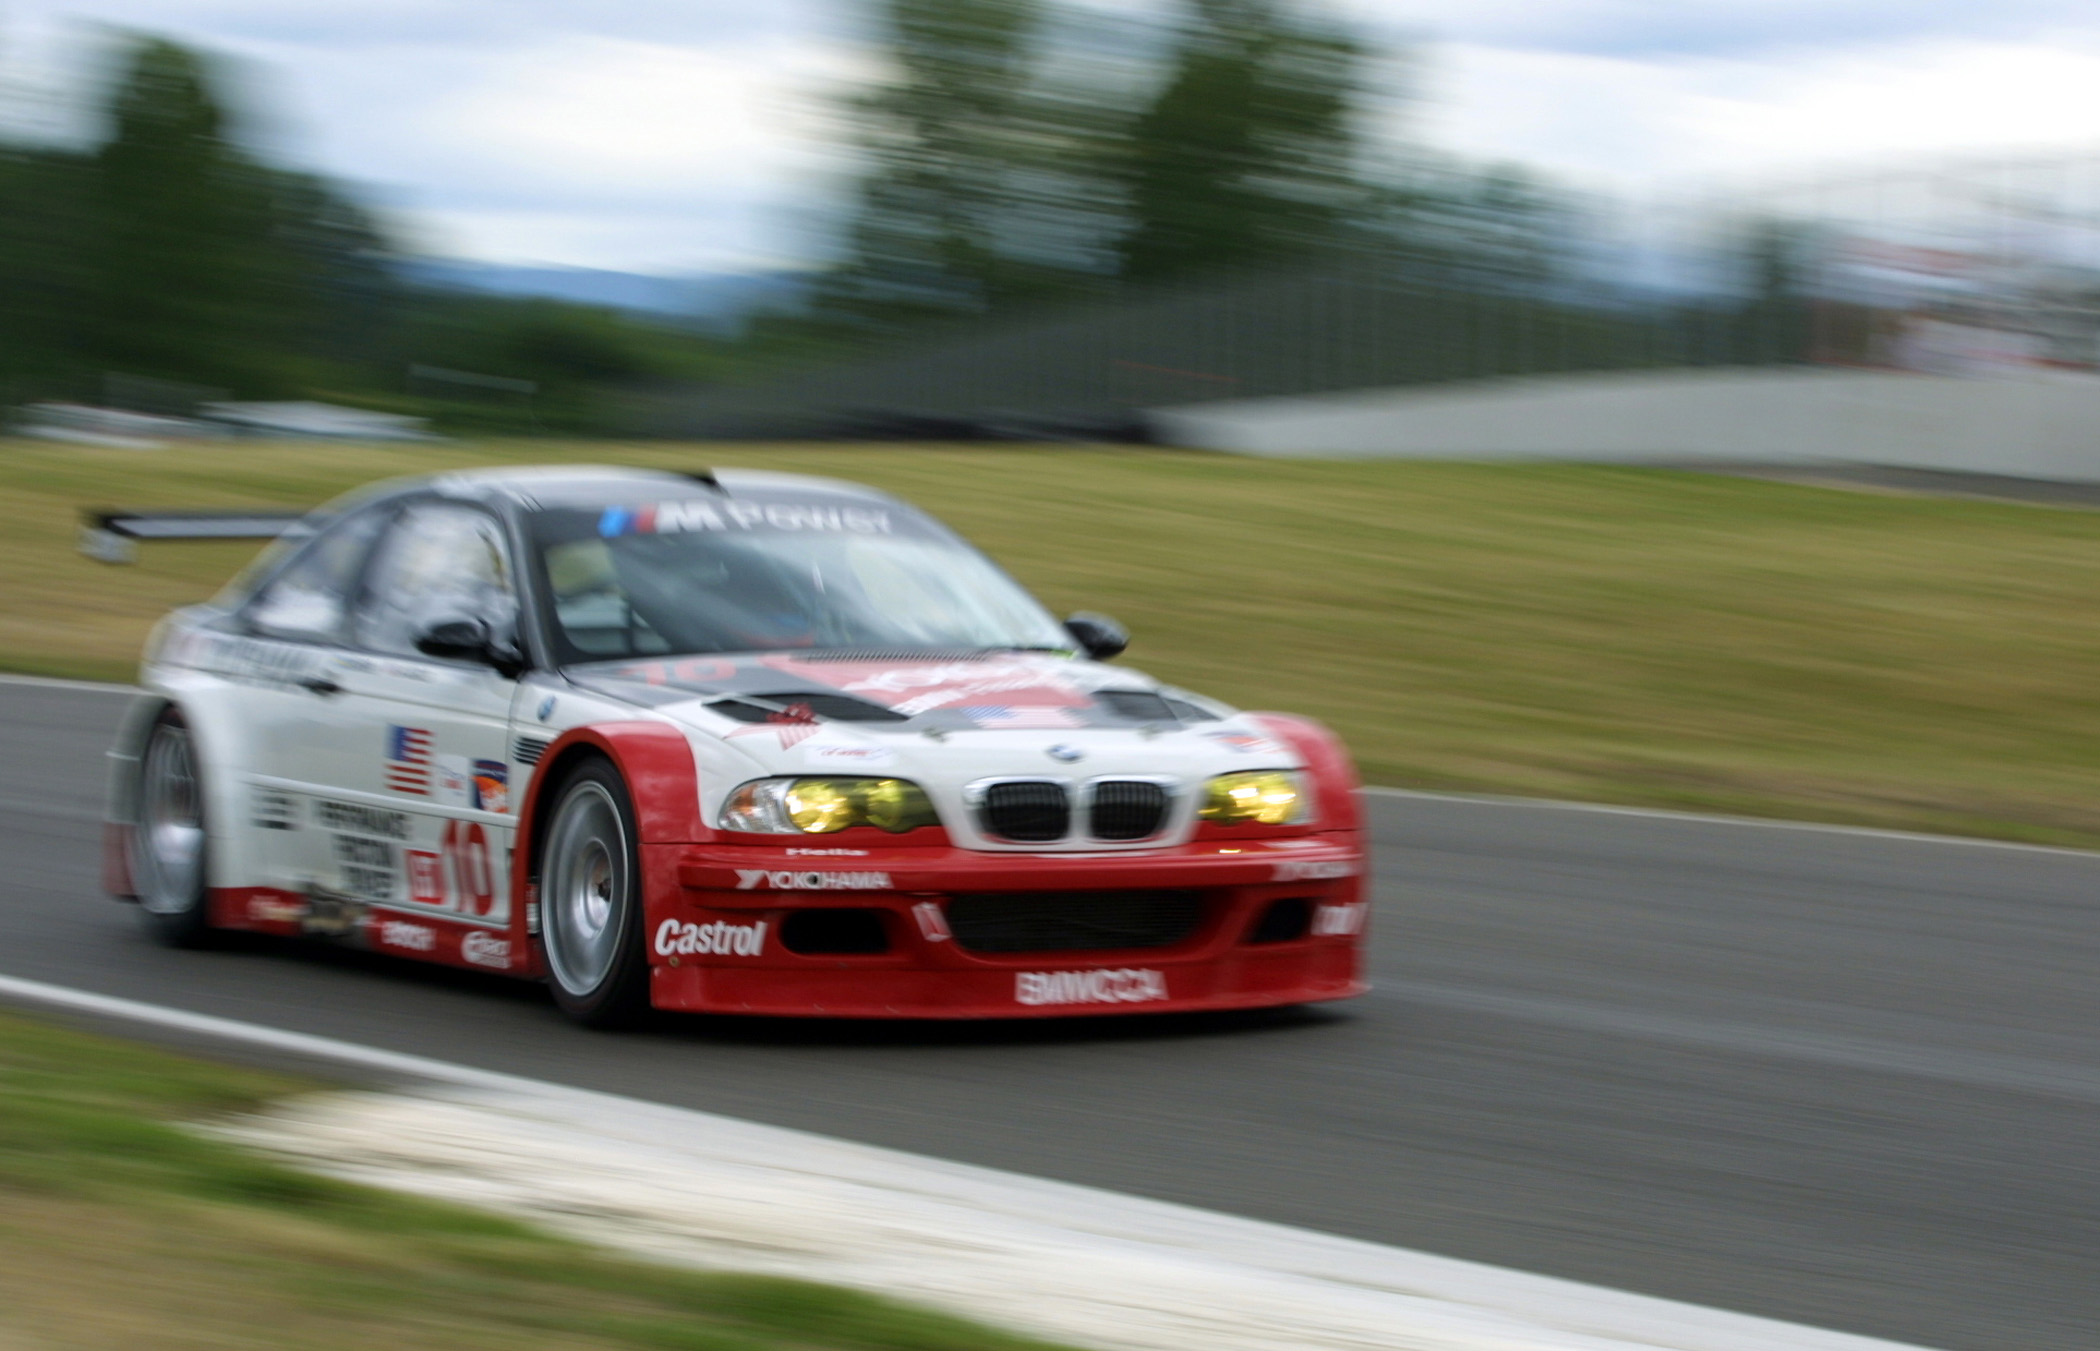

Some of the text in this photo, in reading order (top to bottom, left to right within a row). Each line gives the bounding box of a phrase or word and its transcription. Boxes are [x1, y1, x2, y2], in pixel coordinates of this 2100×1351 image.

[443, 819, 495, 916] 10
[764, 870, 894, 889] YOKOHAMA
[655, 918, 768, 957] Castrol
